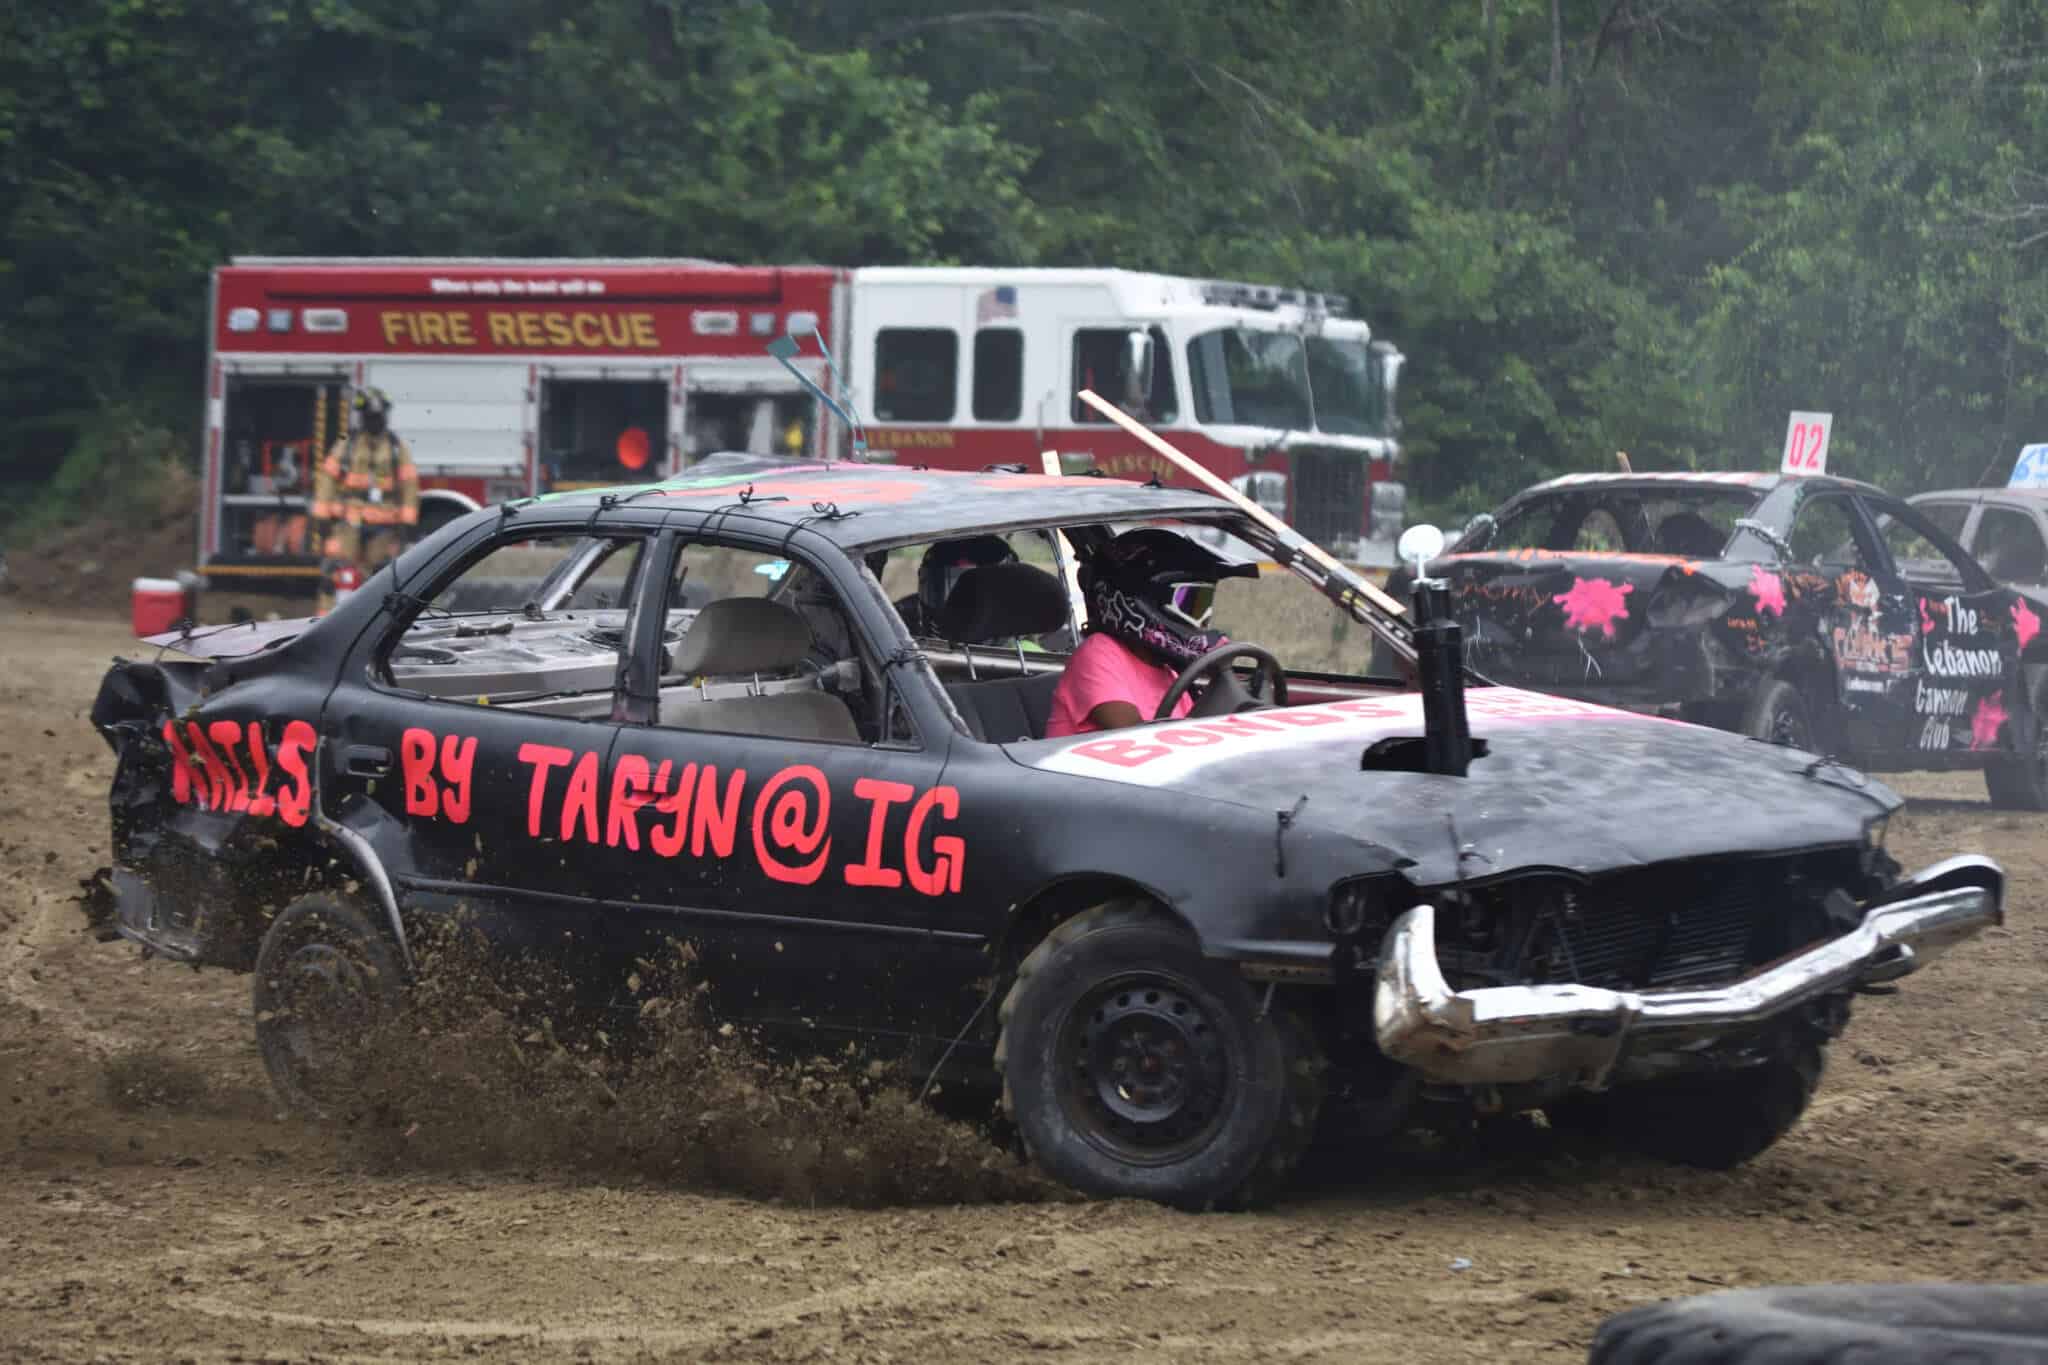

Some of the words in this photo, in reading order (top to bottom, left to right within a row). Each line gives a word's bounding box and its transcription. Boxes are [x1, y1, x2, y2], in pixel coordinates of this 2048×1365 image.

[381, 311, 475, 346] FIRE
[489, 311, 660, 348] RESCUE
[866, 431, 954, 448] LEBANON
[1788, 421, 1824, 469] 02
[1944, 595, 1979, 636] The
[1922, 638, 2003, 676] Lebanon
[401, 727, 479, 824] BY
